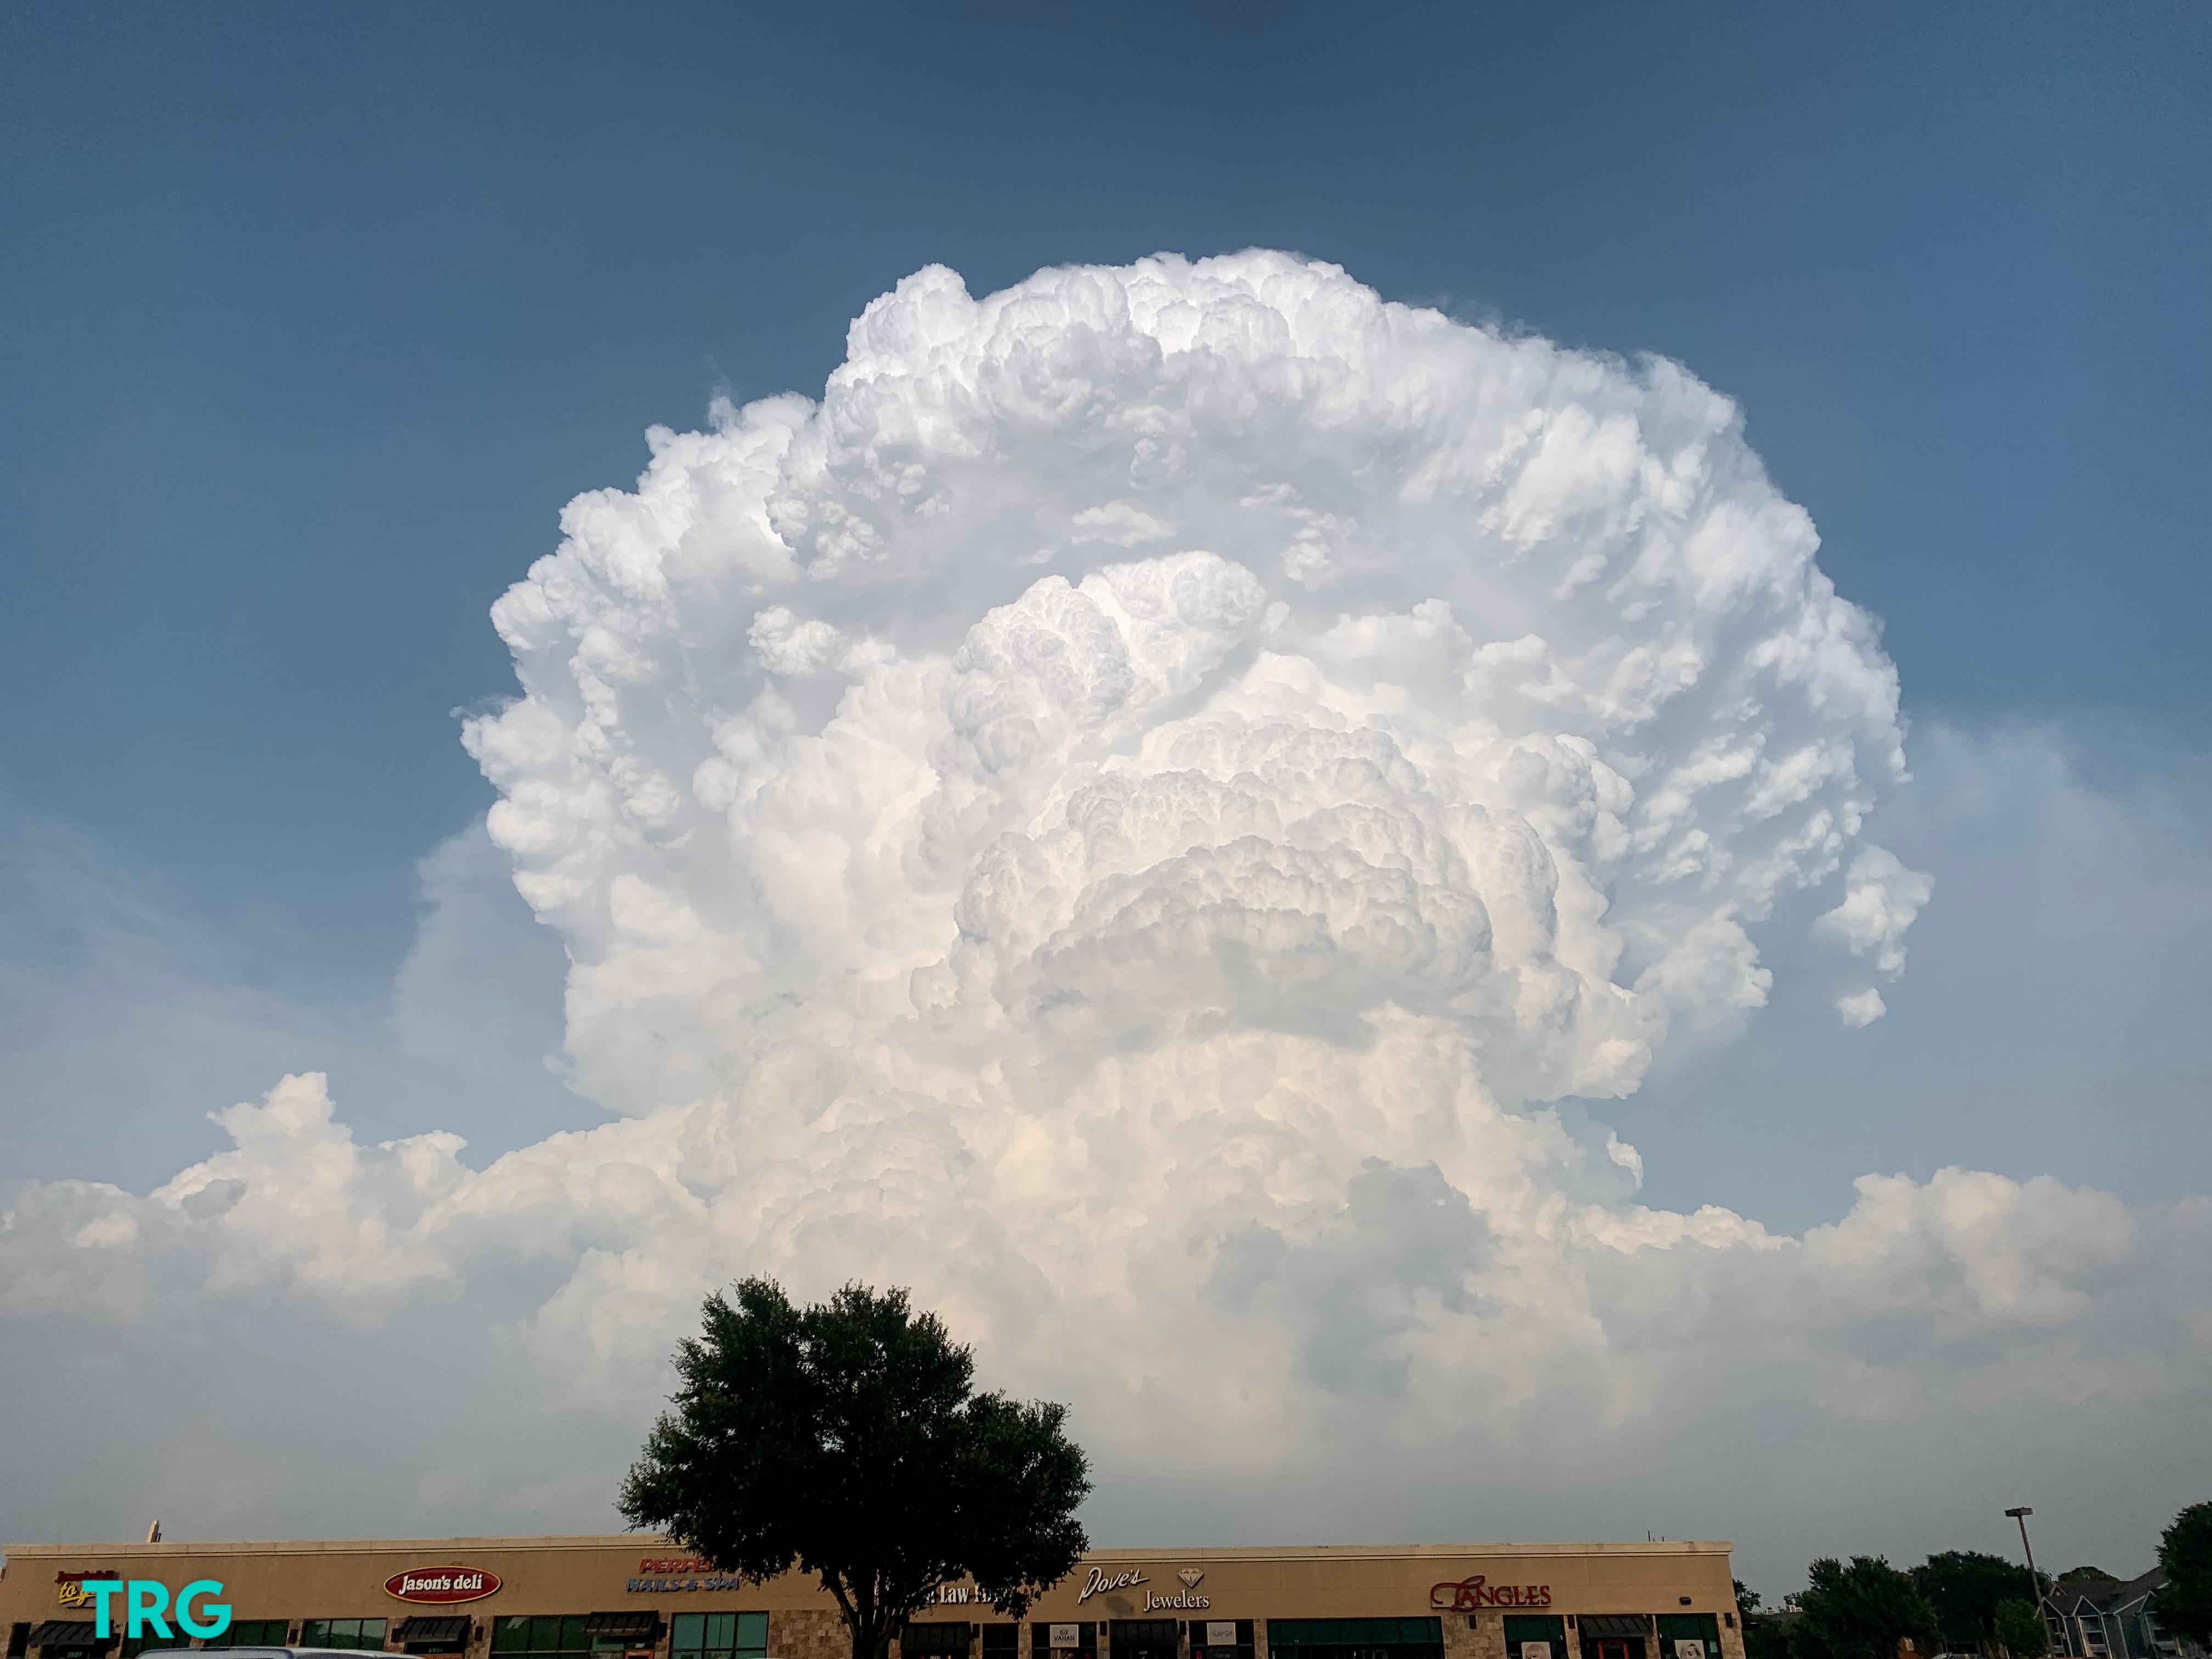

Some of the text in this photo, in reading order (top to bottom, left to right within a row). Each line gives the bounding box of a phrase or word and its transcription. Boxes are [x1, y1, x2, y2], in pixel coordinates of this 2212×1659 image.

[639, 1557, 710, 1573] PERFE
[398, 1574, 483, 1595] Jason's deli
[626, 1578, 739, 1593] NAILS & SPA
[1077, 1567, 1149, 1604] Dove's
[77, 1589, 97, 1606] g
[940, 1585, 969, 1603] Law
[1143, 1589, 1210, 1612] Jewelers
